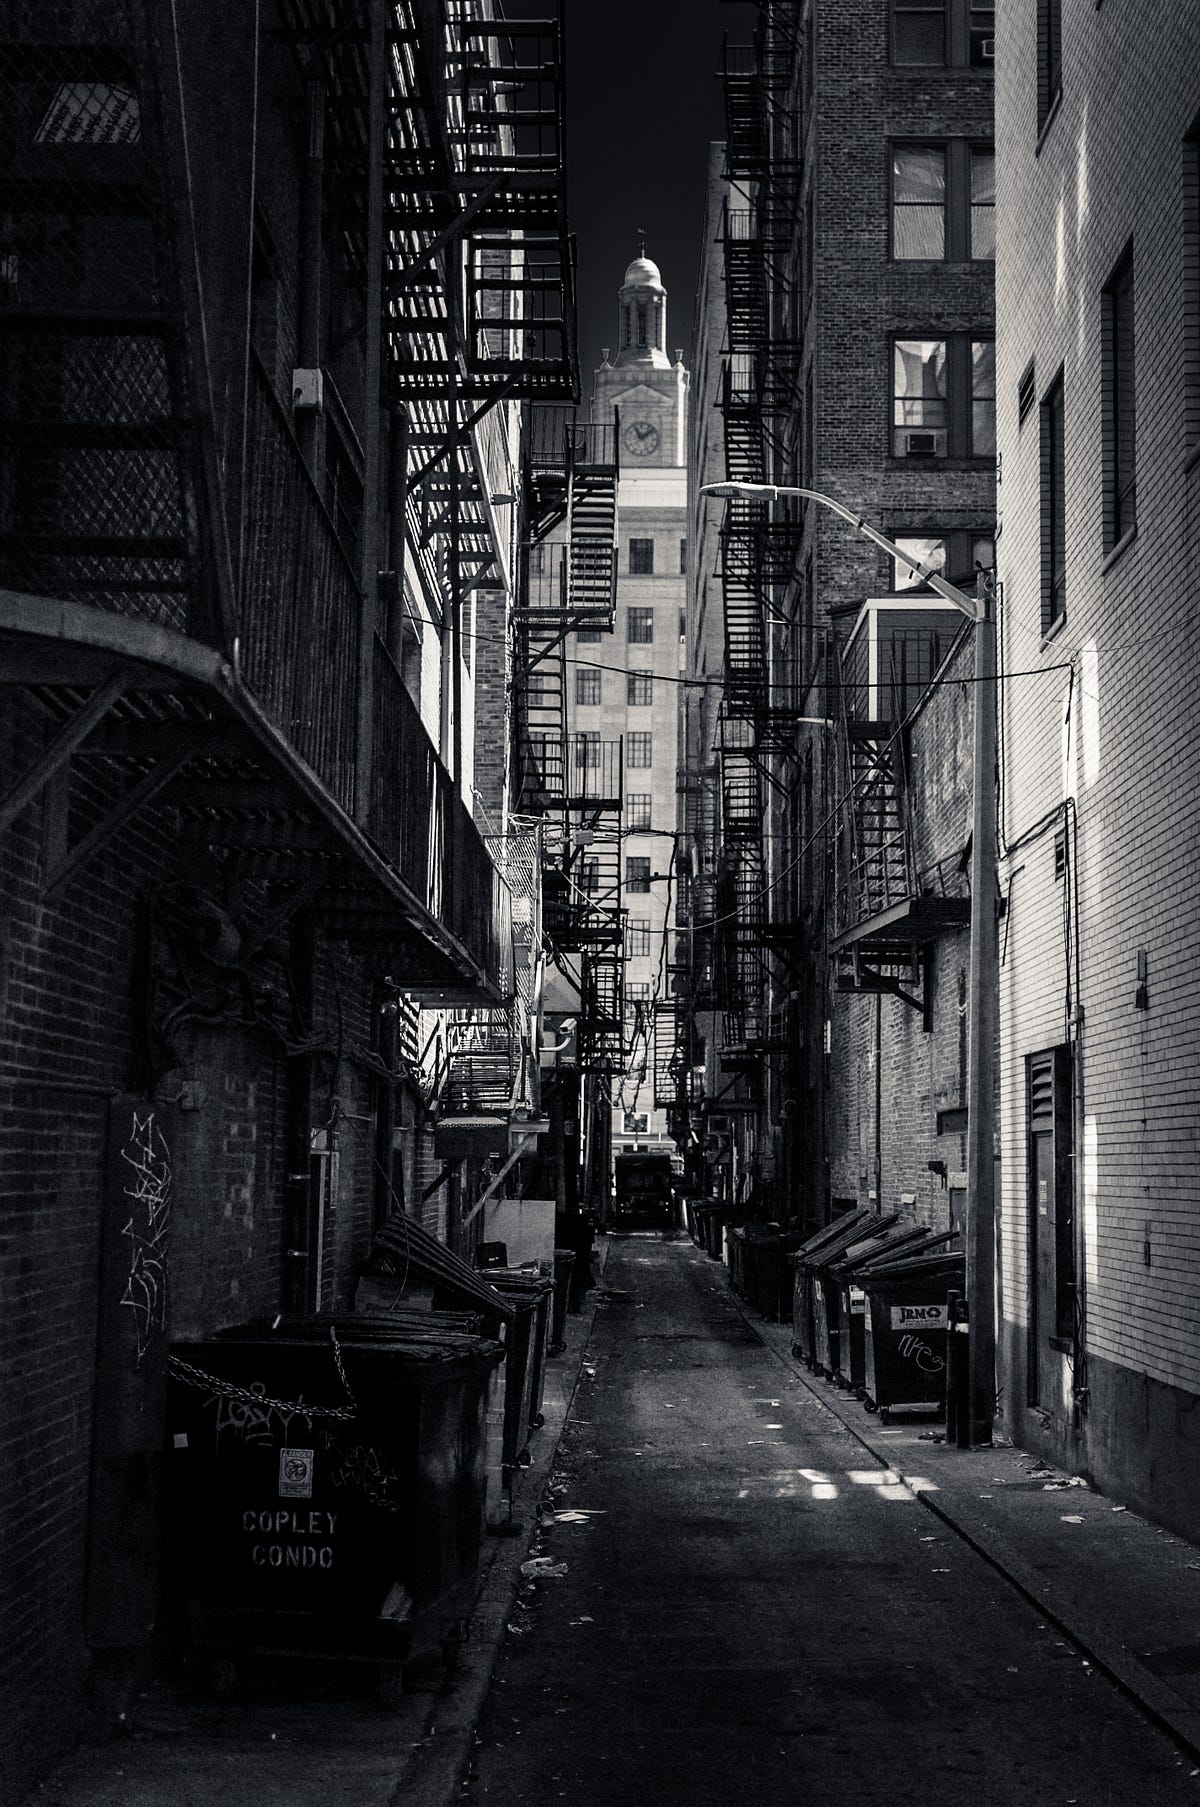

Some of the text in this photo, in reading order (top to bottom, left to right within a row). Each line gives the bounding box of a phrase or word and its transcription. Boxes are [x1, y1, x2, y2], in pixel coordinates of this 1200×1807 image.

[899, 1307, 927, 1323] JRM
[241, 1510, 339, 1535] COPLEY
[252, 1545, 334, 1569] CONDO
